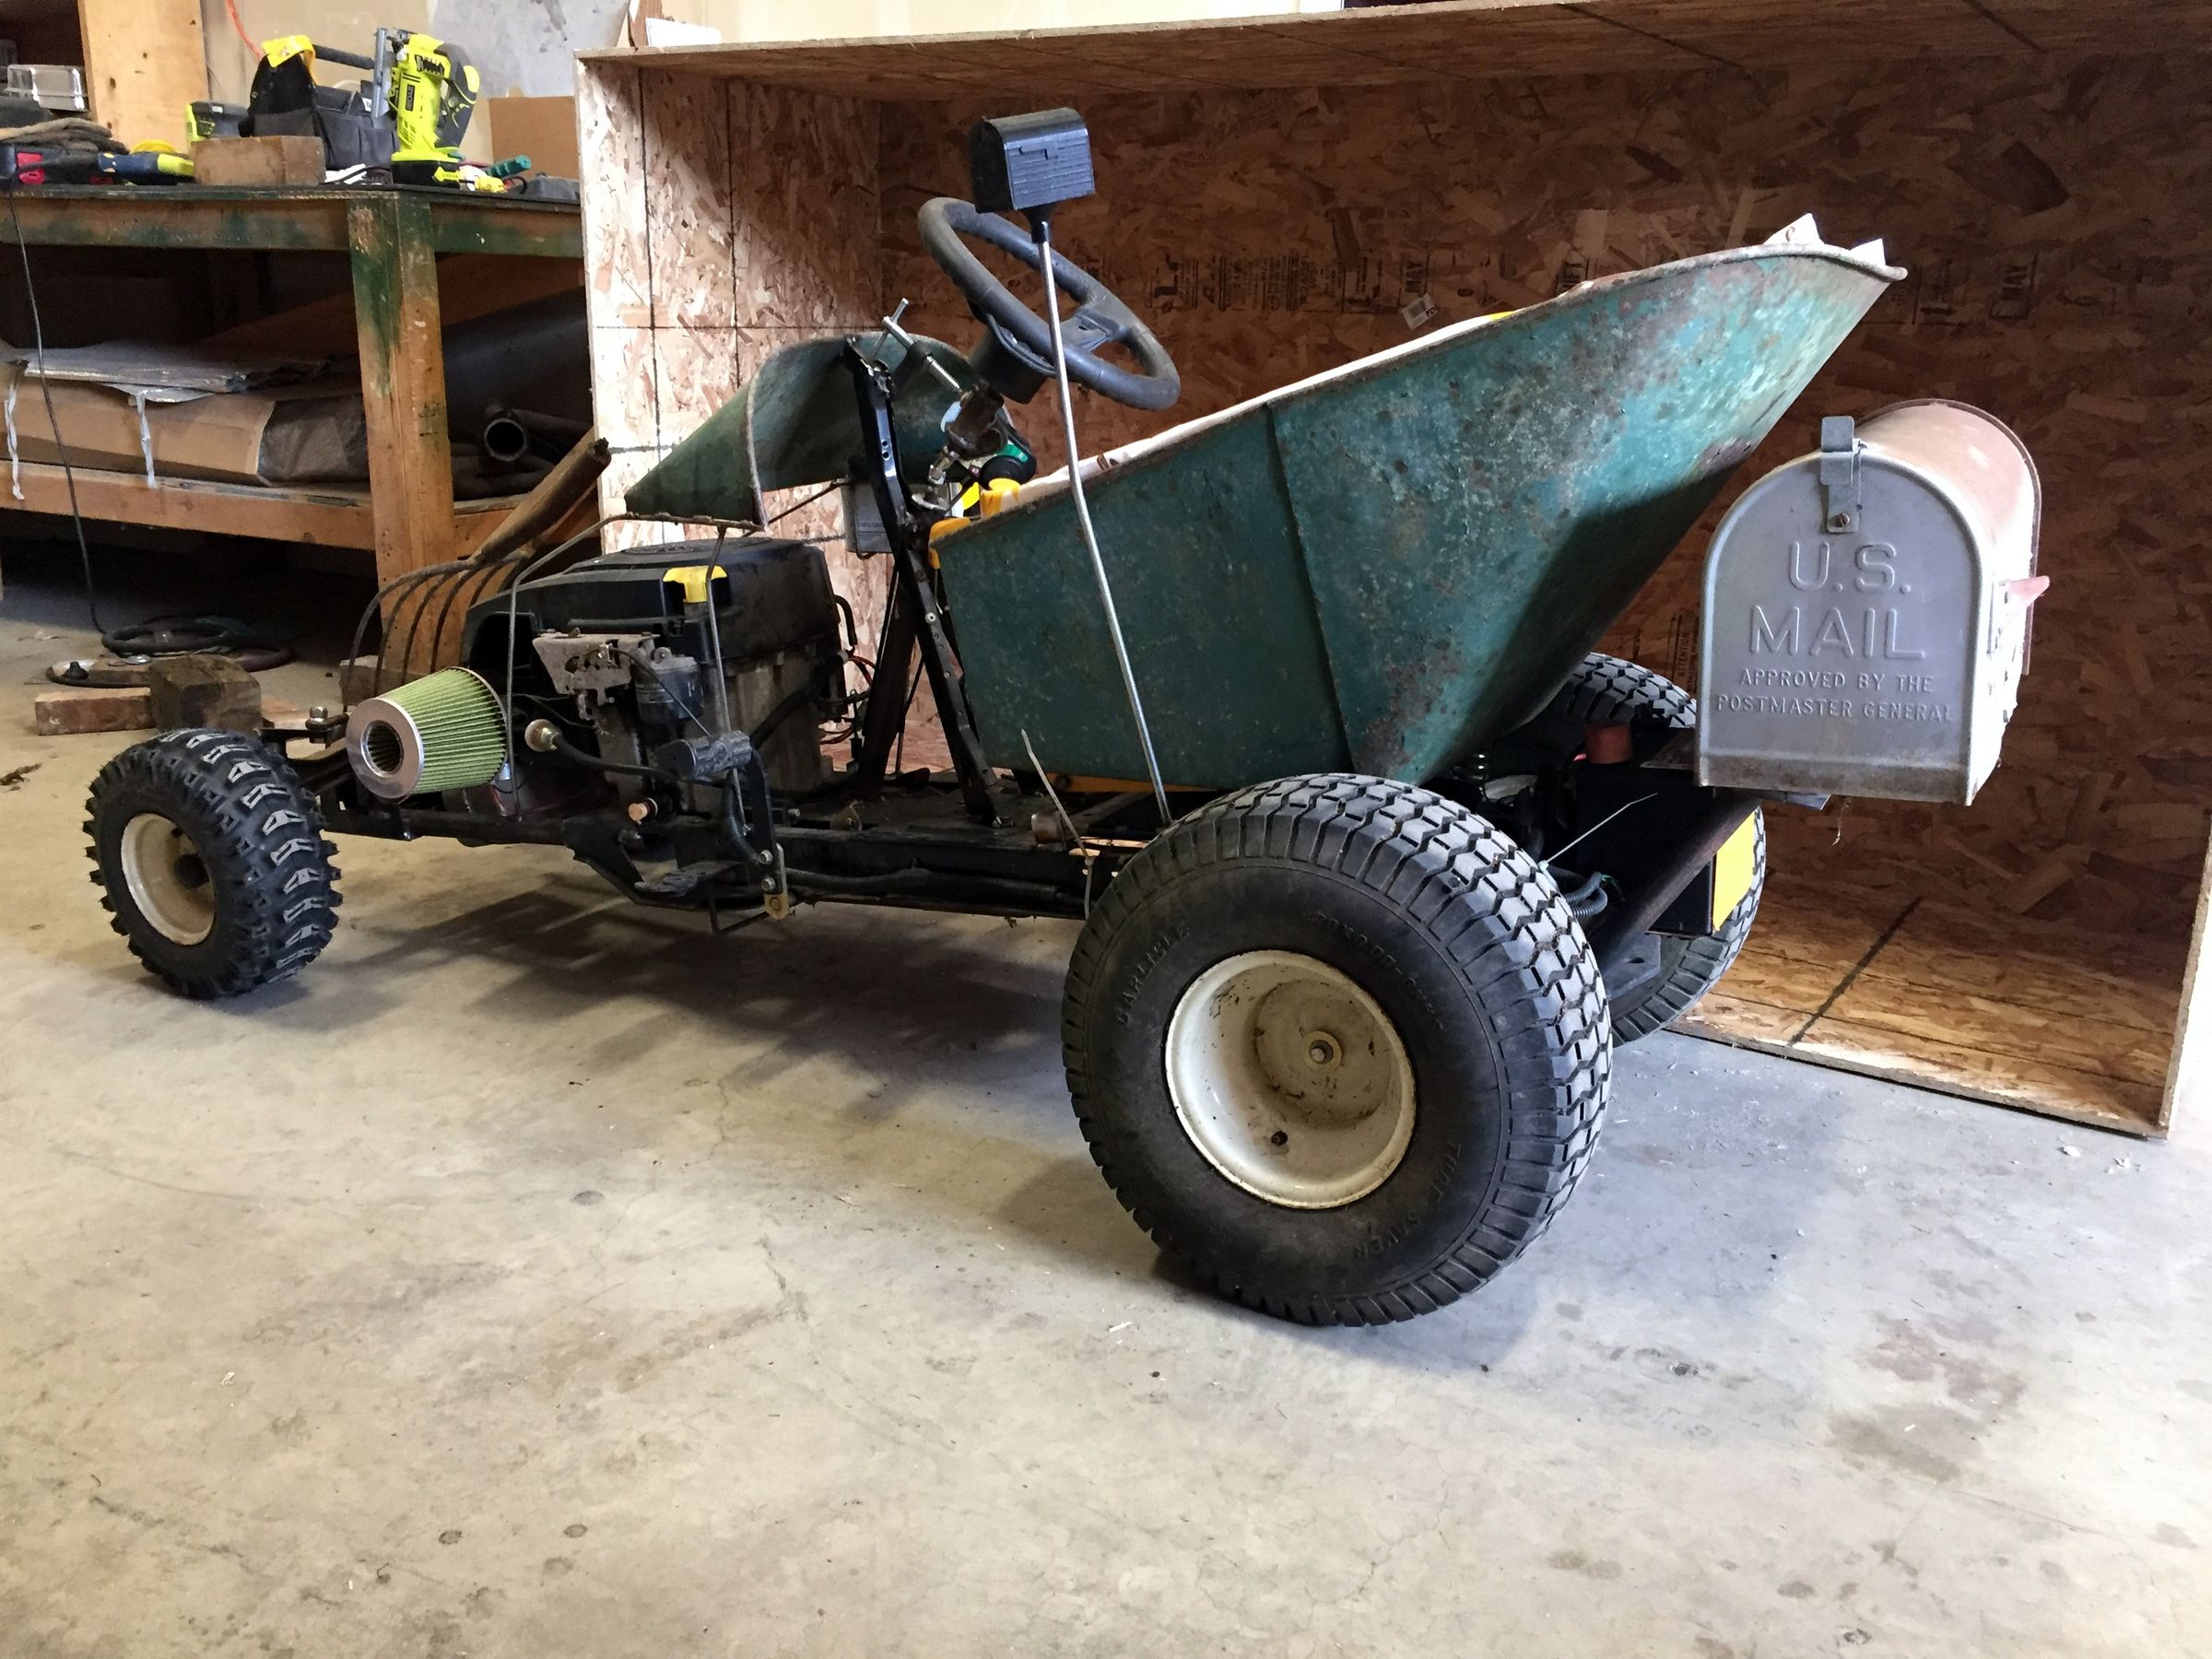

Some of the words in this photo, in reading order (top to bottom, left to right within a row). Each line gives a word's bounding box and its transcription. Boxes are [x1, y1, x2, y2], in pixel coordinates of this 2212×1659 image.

[1789, 541, 1912, 593] U.S.
[1750, 604, 1926, 660] MAIL
[1740, 667, 1846, 689] APPROVED
[1857, 672, 1886, 691] BY
[1895, 675, 1935, 694] THE
[1717, 694, 1853, 717] POSTMASTER
[1863, 700, 1955, 723] GENERAL
